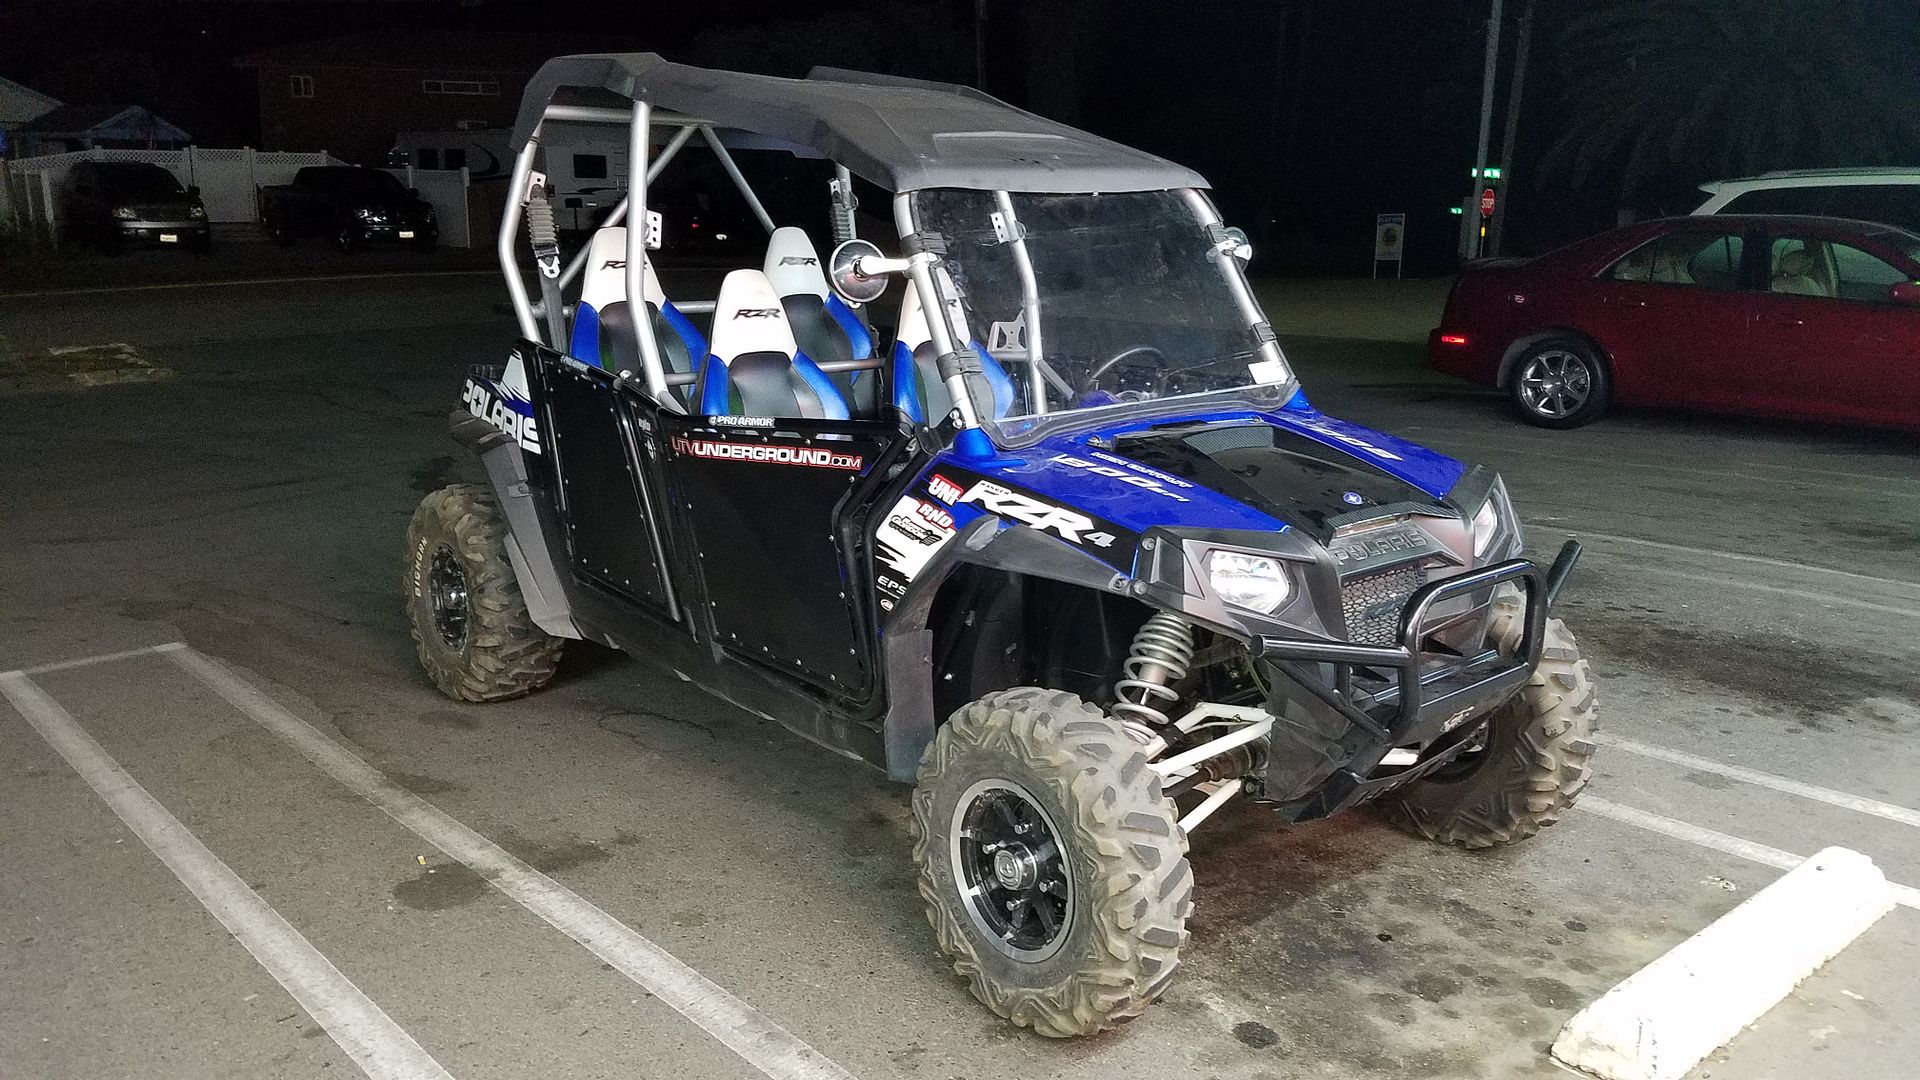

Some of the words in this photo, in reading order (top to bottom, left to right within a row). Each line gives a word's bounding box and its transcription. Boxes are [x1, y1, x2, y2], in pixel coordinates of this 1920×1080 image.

[778, 256, 816, 267] RZR
[733, 308, 780, 320] RZR
[737, 416, 775, 429] ARMOR
[928, 477, 961, 506] UNI
[956, 480, 1095, 545] RZR
[1083, 531, 1118, 548] 4
[1331, 528, 1428, 565] POLARIS
[877, 575, 907, 596] EPS
